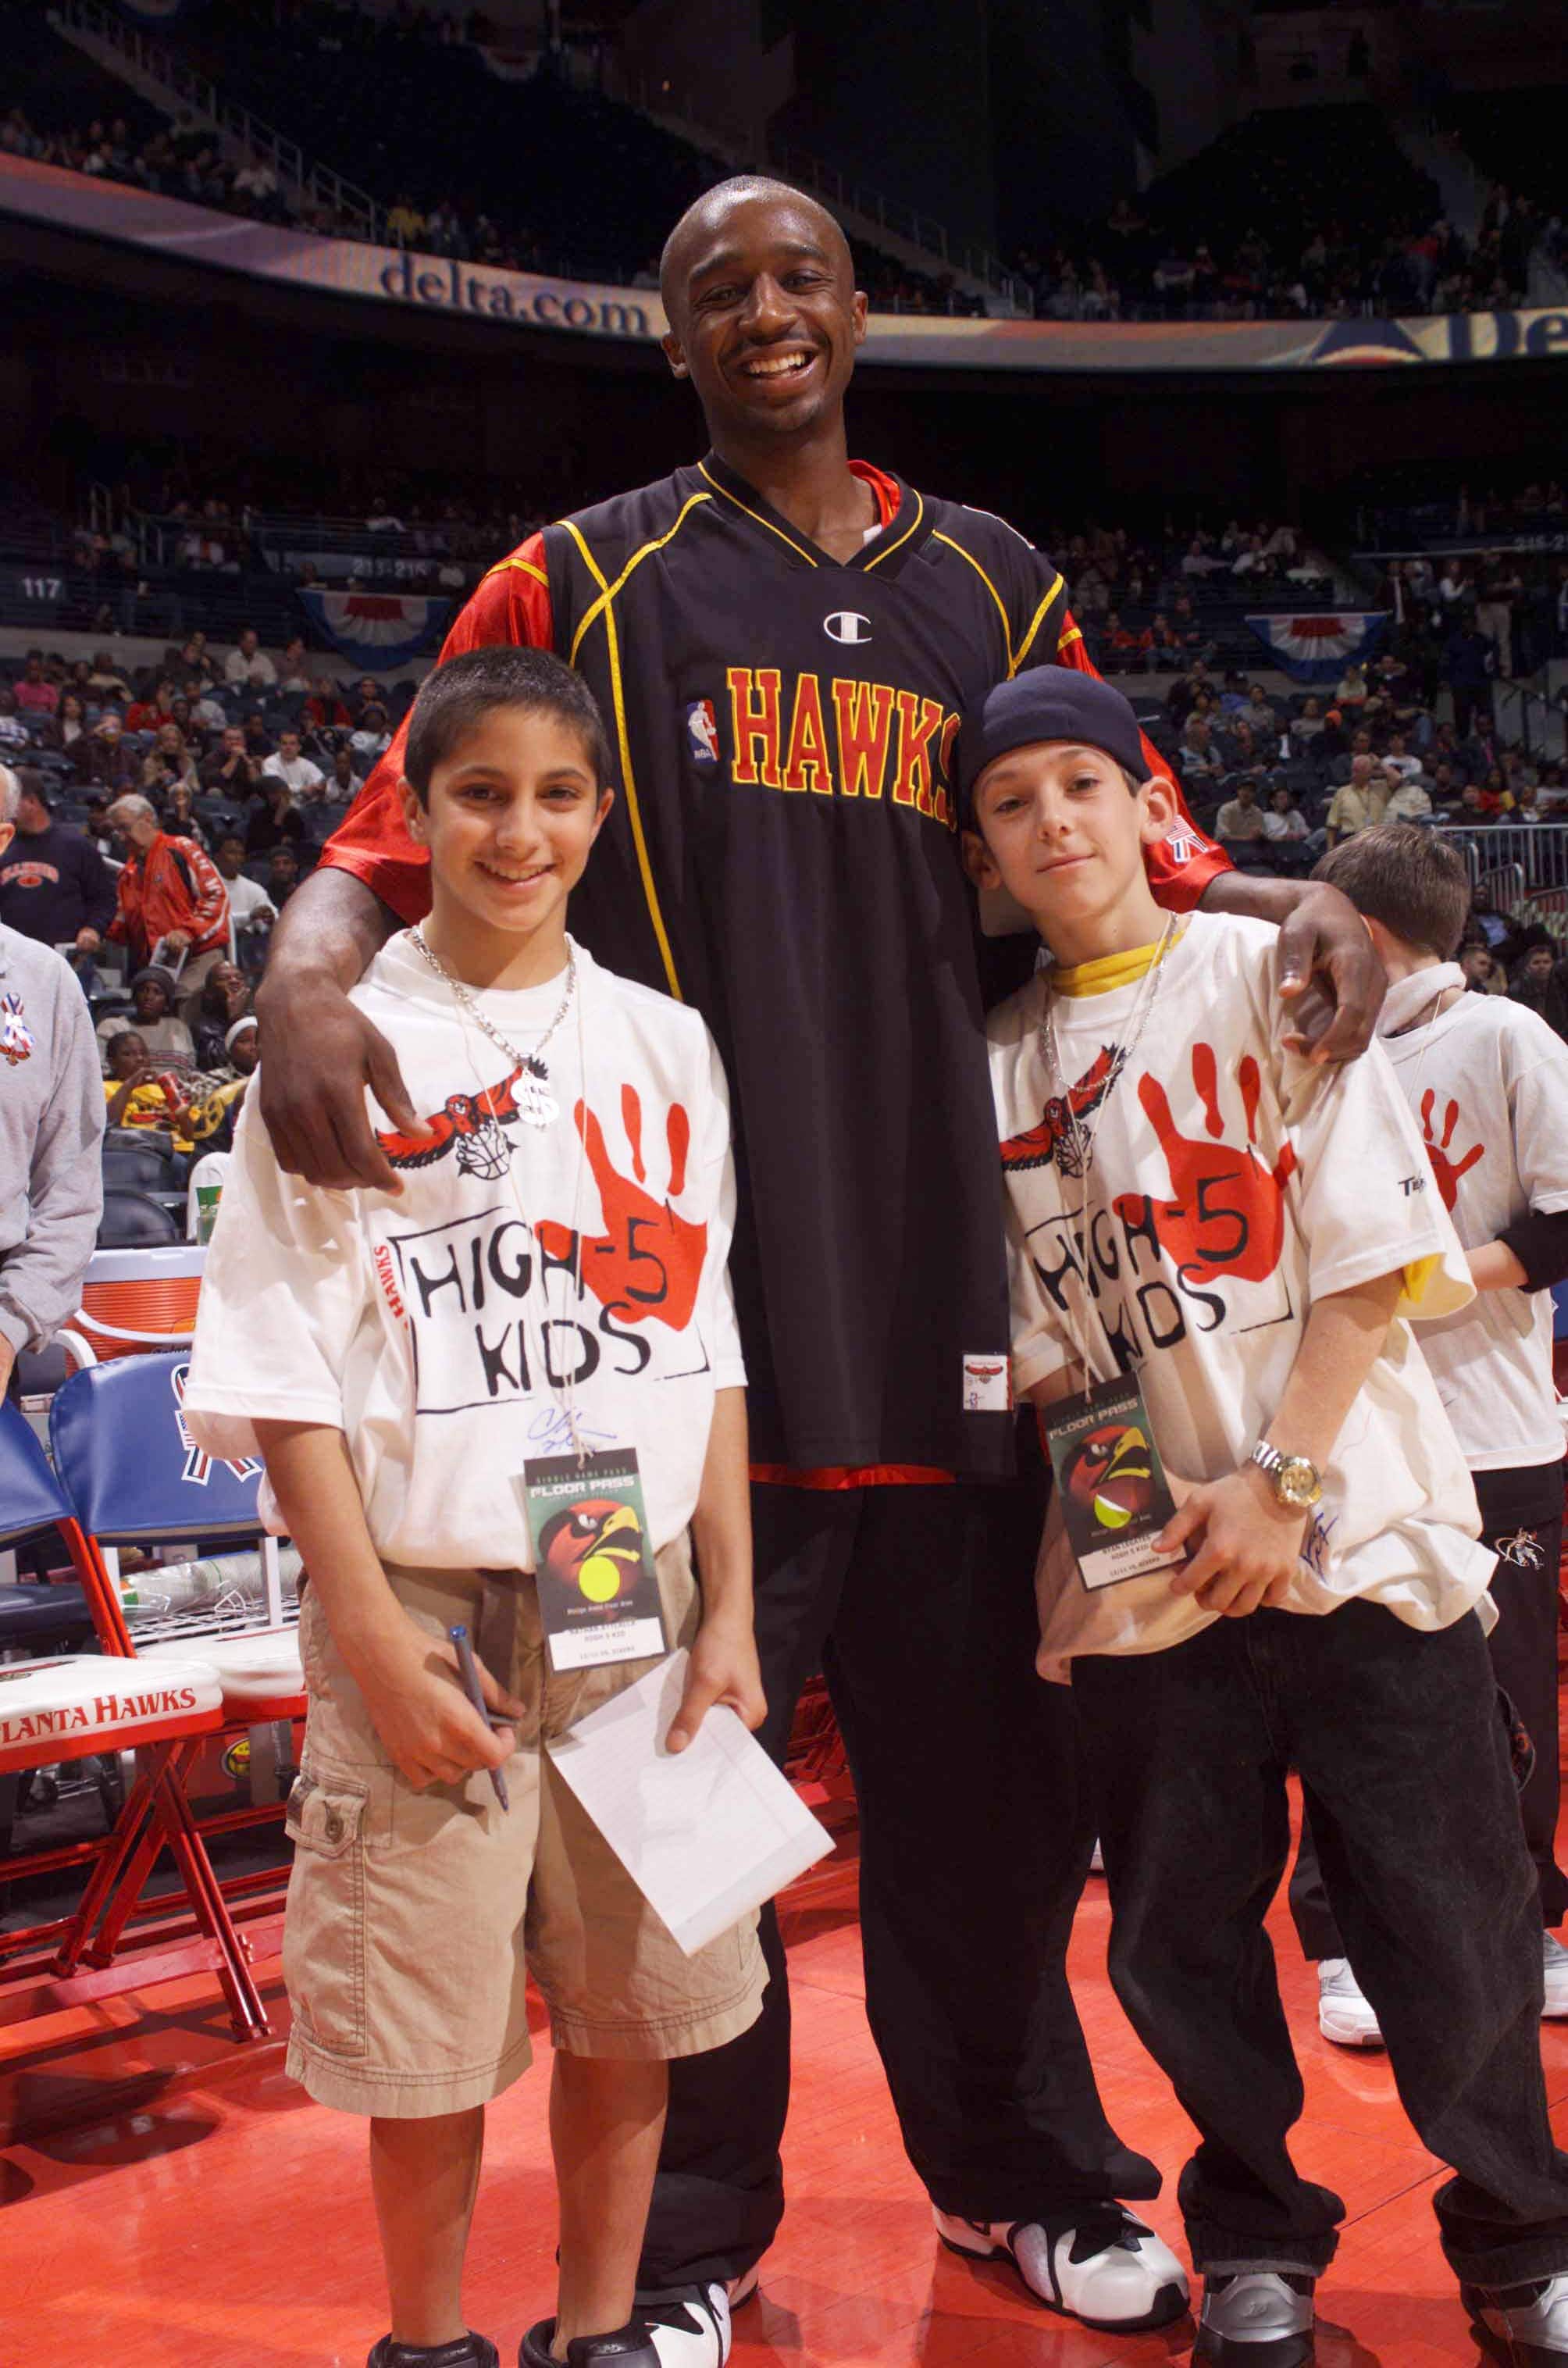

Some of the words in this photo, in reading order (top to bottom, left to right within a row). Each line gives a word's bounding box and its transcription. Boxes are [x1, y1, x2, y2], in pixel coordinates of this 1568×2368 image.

[380, 254, 649, 335] delta.com
[21, 577, 61, 599] 117
[694, 749, 712, 759] NBA
[374, 1245, 404, 1318] HAWKS
[410, 1217, 667, 1318] HIGH-5
[476, 1301, 651, 1396] KIDS
[1049, 1414, 1094, 1439] FLOOR
[1098, 1397, 1138, 1421] PASS
[530, 1481, 586, 1499] FLOOR
[590, 1475, 635, 1491] PASS
[0, 1706, 90, 1744] LANTA
[91, 1687, 197, 1724] HAWKS
